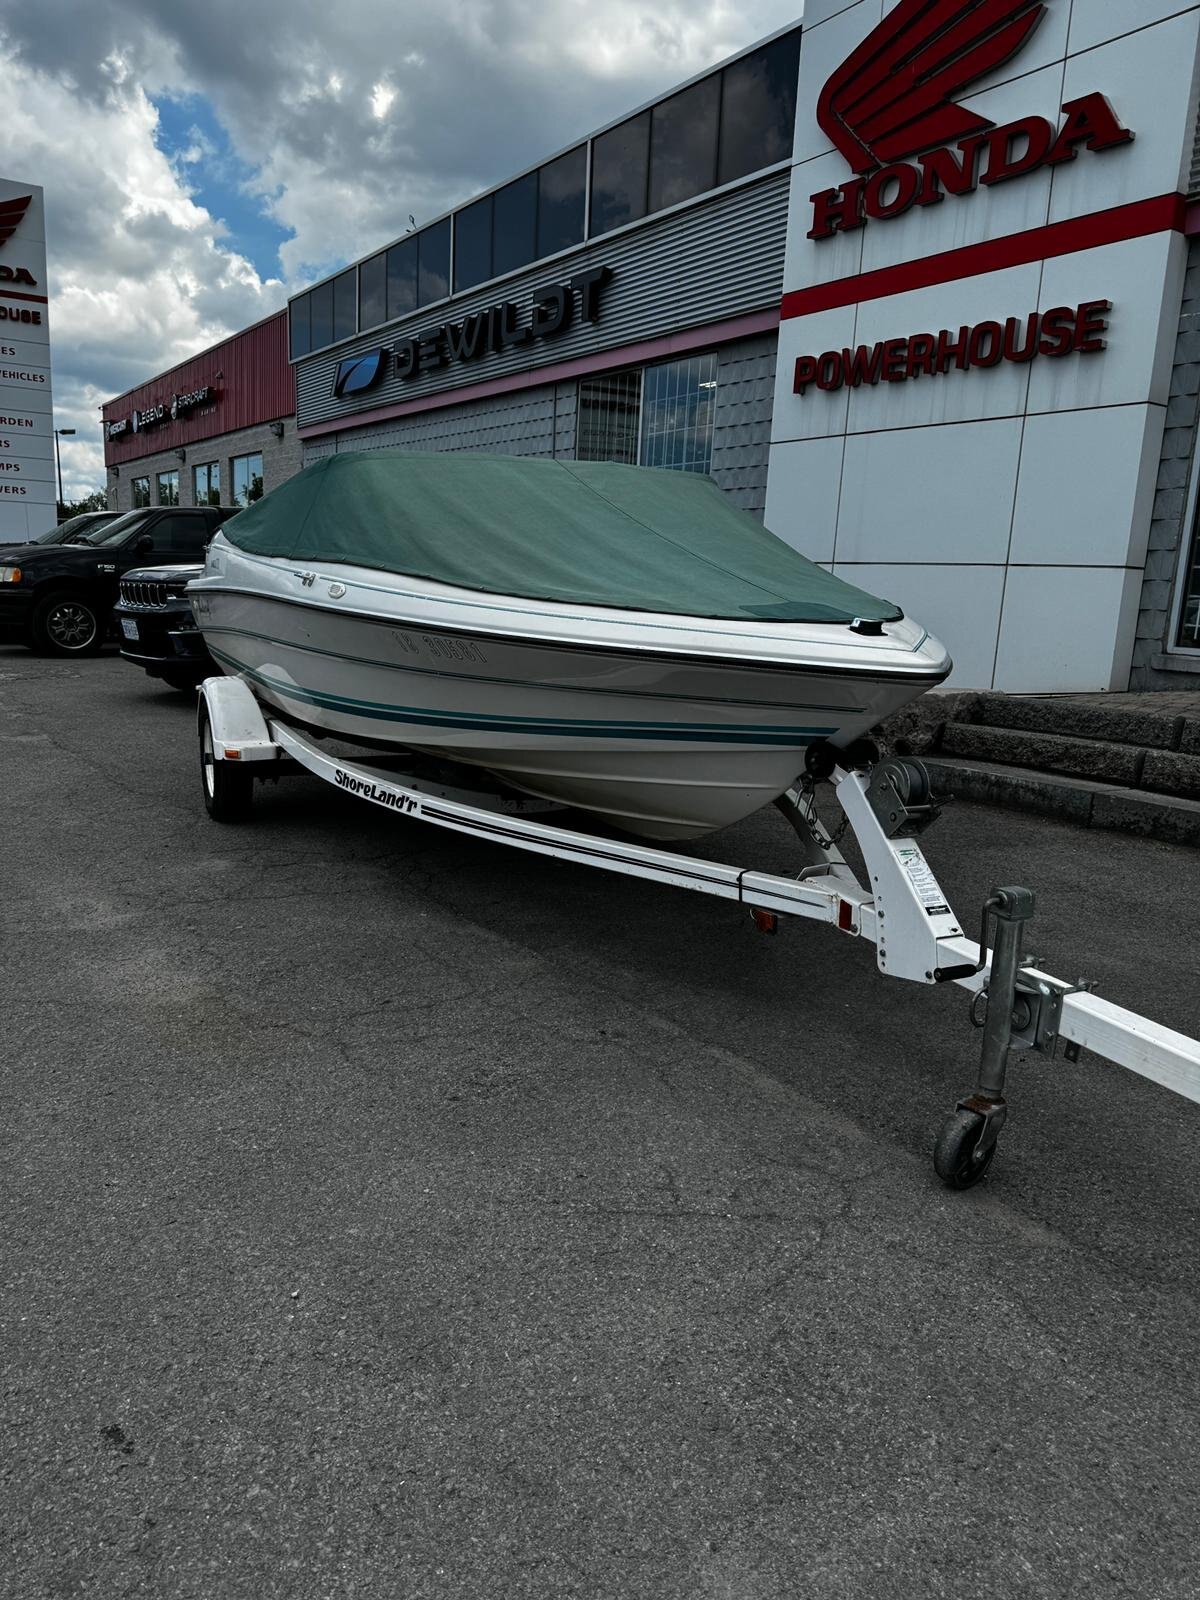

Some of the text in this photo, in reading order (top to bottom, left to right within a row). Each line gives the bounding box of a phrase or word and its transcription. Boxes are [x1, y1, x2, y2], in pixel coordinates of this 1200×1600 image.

[806, 91, 1135, 240] HONDA
[393, 266, 613, 381] DEWILDT
[793, 299, 1113, 395] POWERHOUSE
[0, 370, 46, 383] EHICLES
[138, 404, 164, 426] LEGEND
[0, 485, 27, 495] ERS
[334, 769, 418, 813] ShoreLand'r
